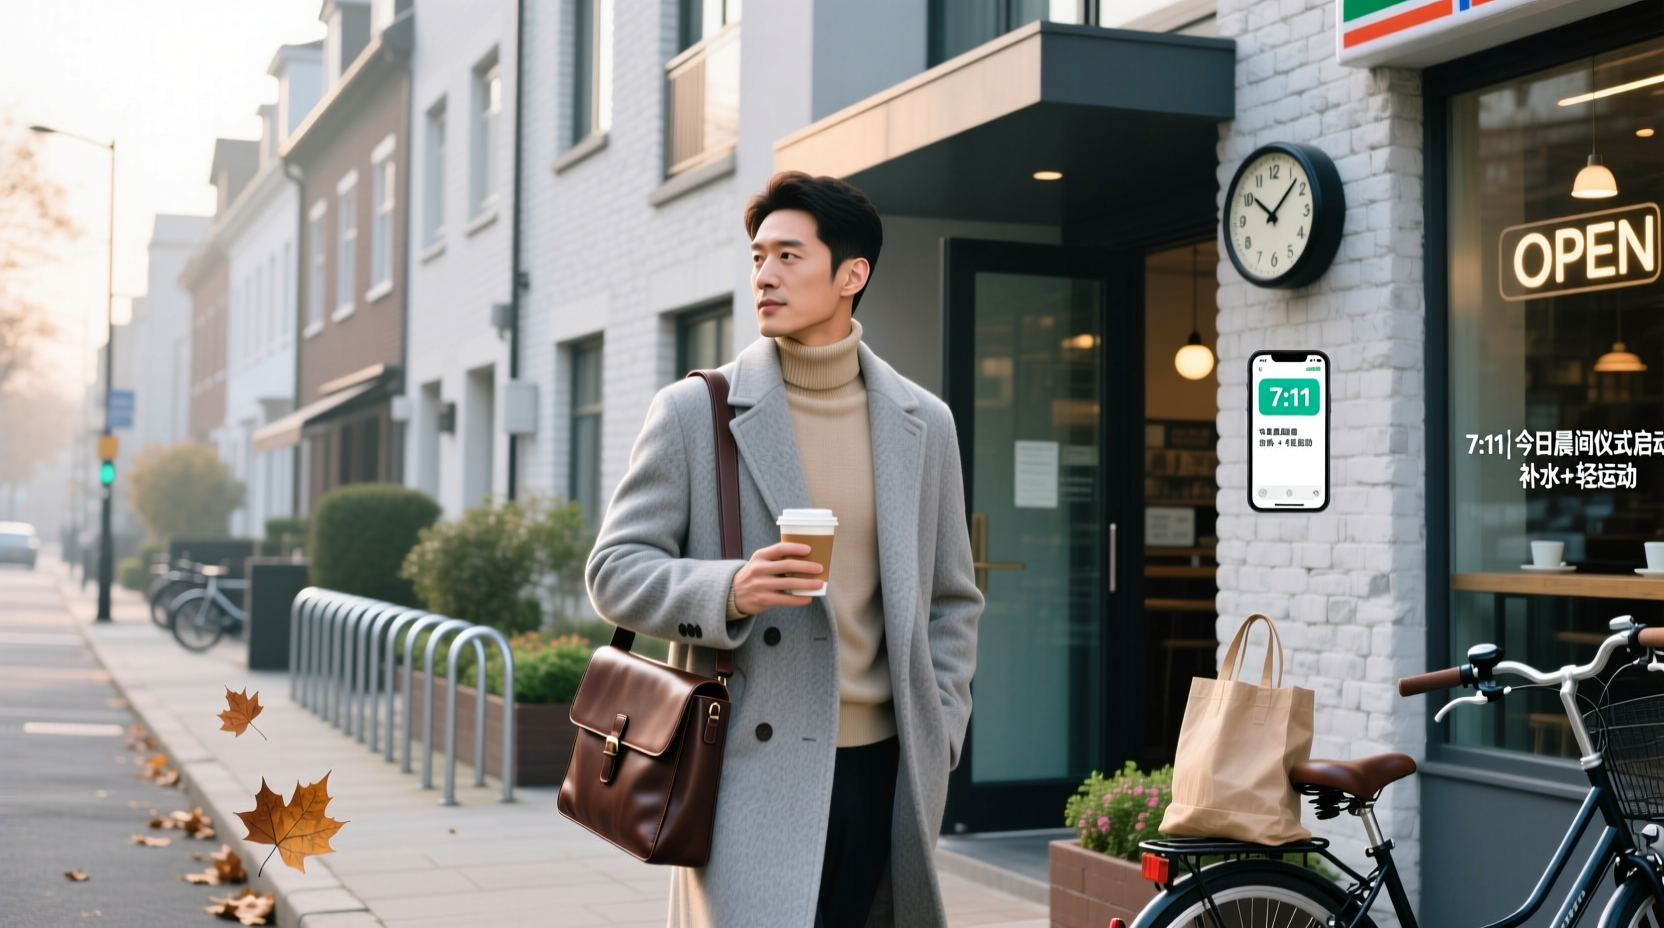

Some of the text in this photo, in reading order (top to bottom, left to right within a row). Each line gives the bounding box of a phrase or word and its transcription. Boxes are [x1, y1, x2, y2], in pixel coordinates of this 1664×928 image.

[1269, 164, 1280, 180] 12
[1255, 174, 1263, 188] 11
[1298, 182, 1306, 197] 2
[1302, 203, 1310, 217] 3
[1239, 215, 1247, 228] 9
[1296, 225, 1304, 239] 4
[1256, 251, 1263, 265] 7
[1287, 244, 1294, 258] 5
[1513, 214, 1654, 288] OPEN
[1270, 251, 1278, 267] 6
[1269, 387, 1310, 407] 7:11
[1519, 461, 1637, 490] 补水+轻运动
